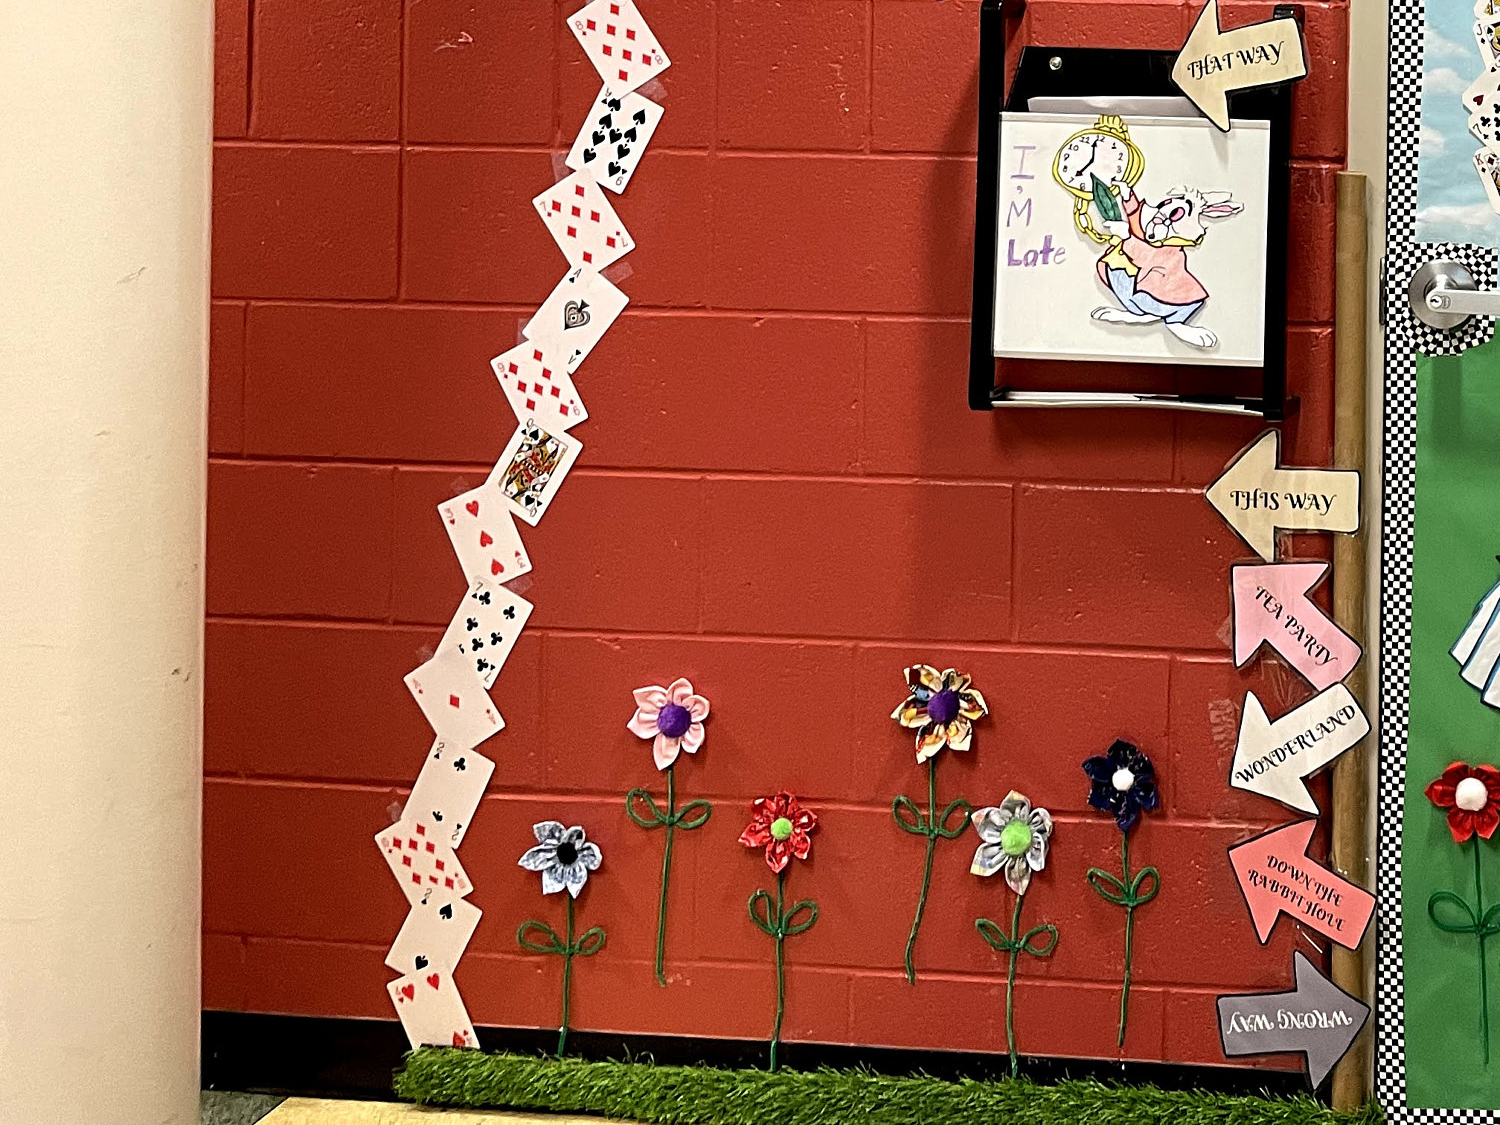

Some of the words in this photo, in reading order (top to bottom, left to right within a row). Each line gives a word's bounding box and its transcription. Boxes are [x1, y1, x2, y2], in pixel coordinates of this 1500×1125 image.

[1188, 52, 1234, 80] THAT
[1237, 41, 1284, 65] WAY
[1118, 153, 1123, 161] 2
[1007, 235, 1067, 267] Late
[1230, 488, 1280, 510] THIS
[1284, 493, 1337, 515] WAY
[1255, 586, 1283, 620] TEA
[1286, 614, 1338, 666] PARTY
[1235, 705, 1356, 783] WONDERLAND
[1267, 855, 1314, 890] DOWN
[1314, 882, 1344, 907] THE
[1248, 870, 1304, 906] RABBIT
[1303, 901, 1345, 931] HOLE
[1227, 1012, 1274, 1034] WAY
[1277, 1009, 1352, 1029] WRONG
